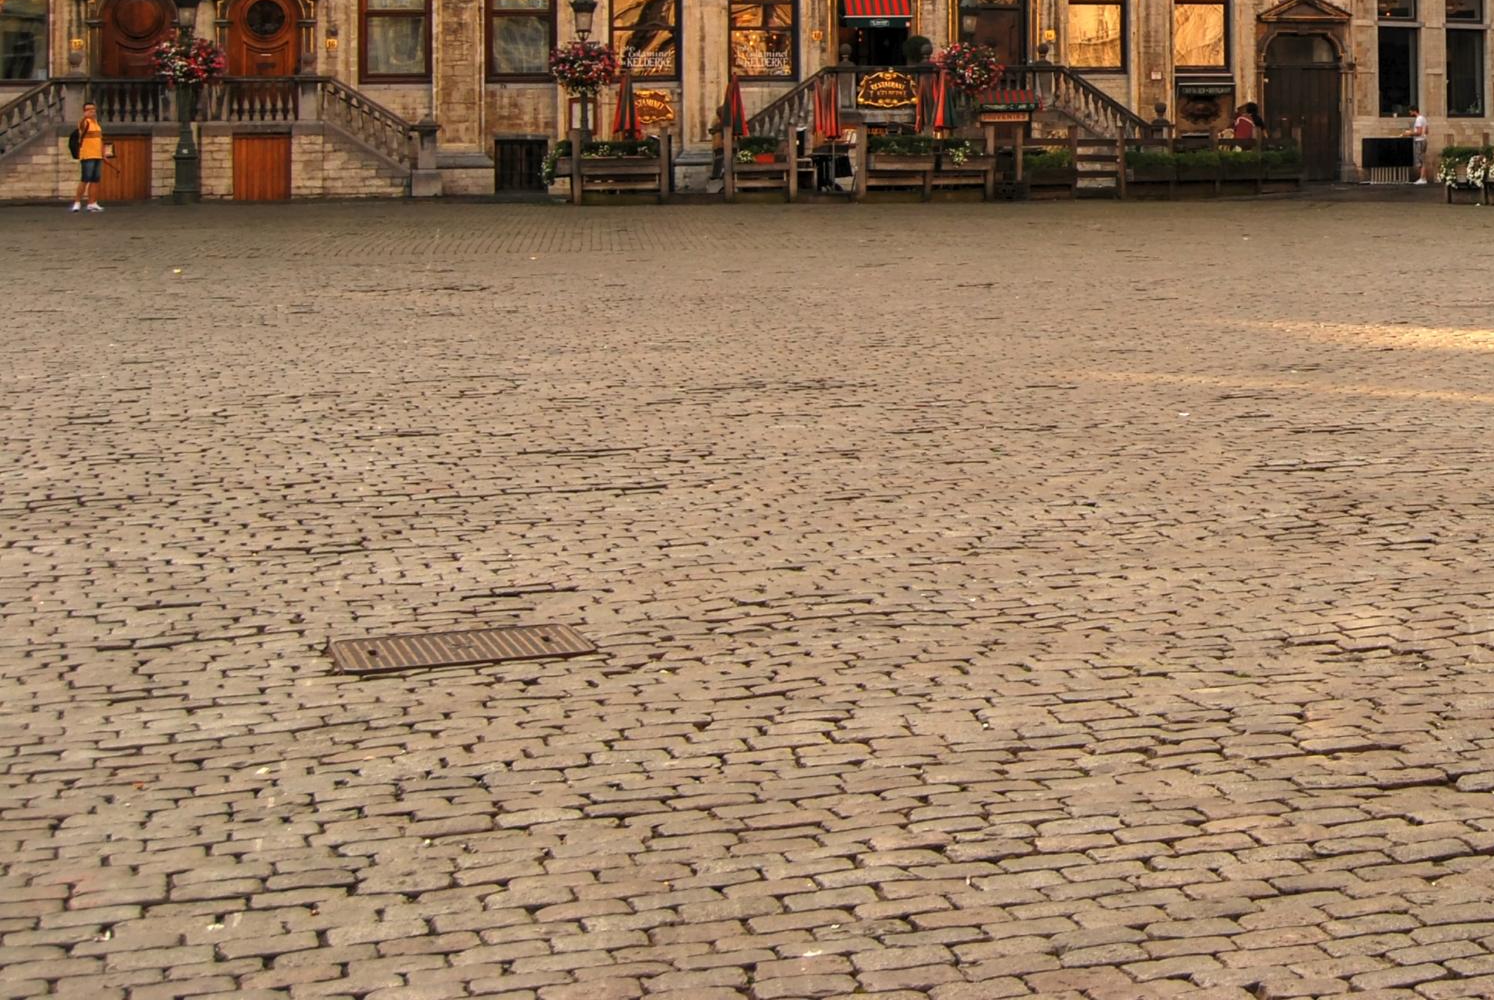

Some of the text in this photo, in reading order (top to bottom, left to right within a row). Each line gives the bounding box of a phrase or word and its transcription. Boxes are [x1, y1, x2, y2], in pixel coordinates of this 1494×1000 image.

[627, 57, 672, 67] KELDERKE
[744, 57, 789, 67] KELDERKE
[635, 98, 665, 110] STAMINET
